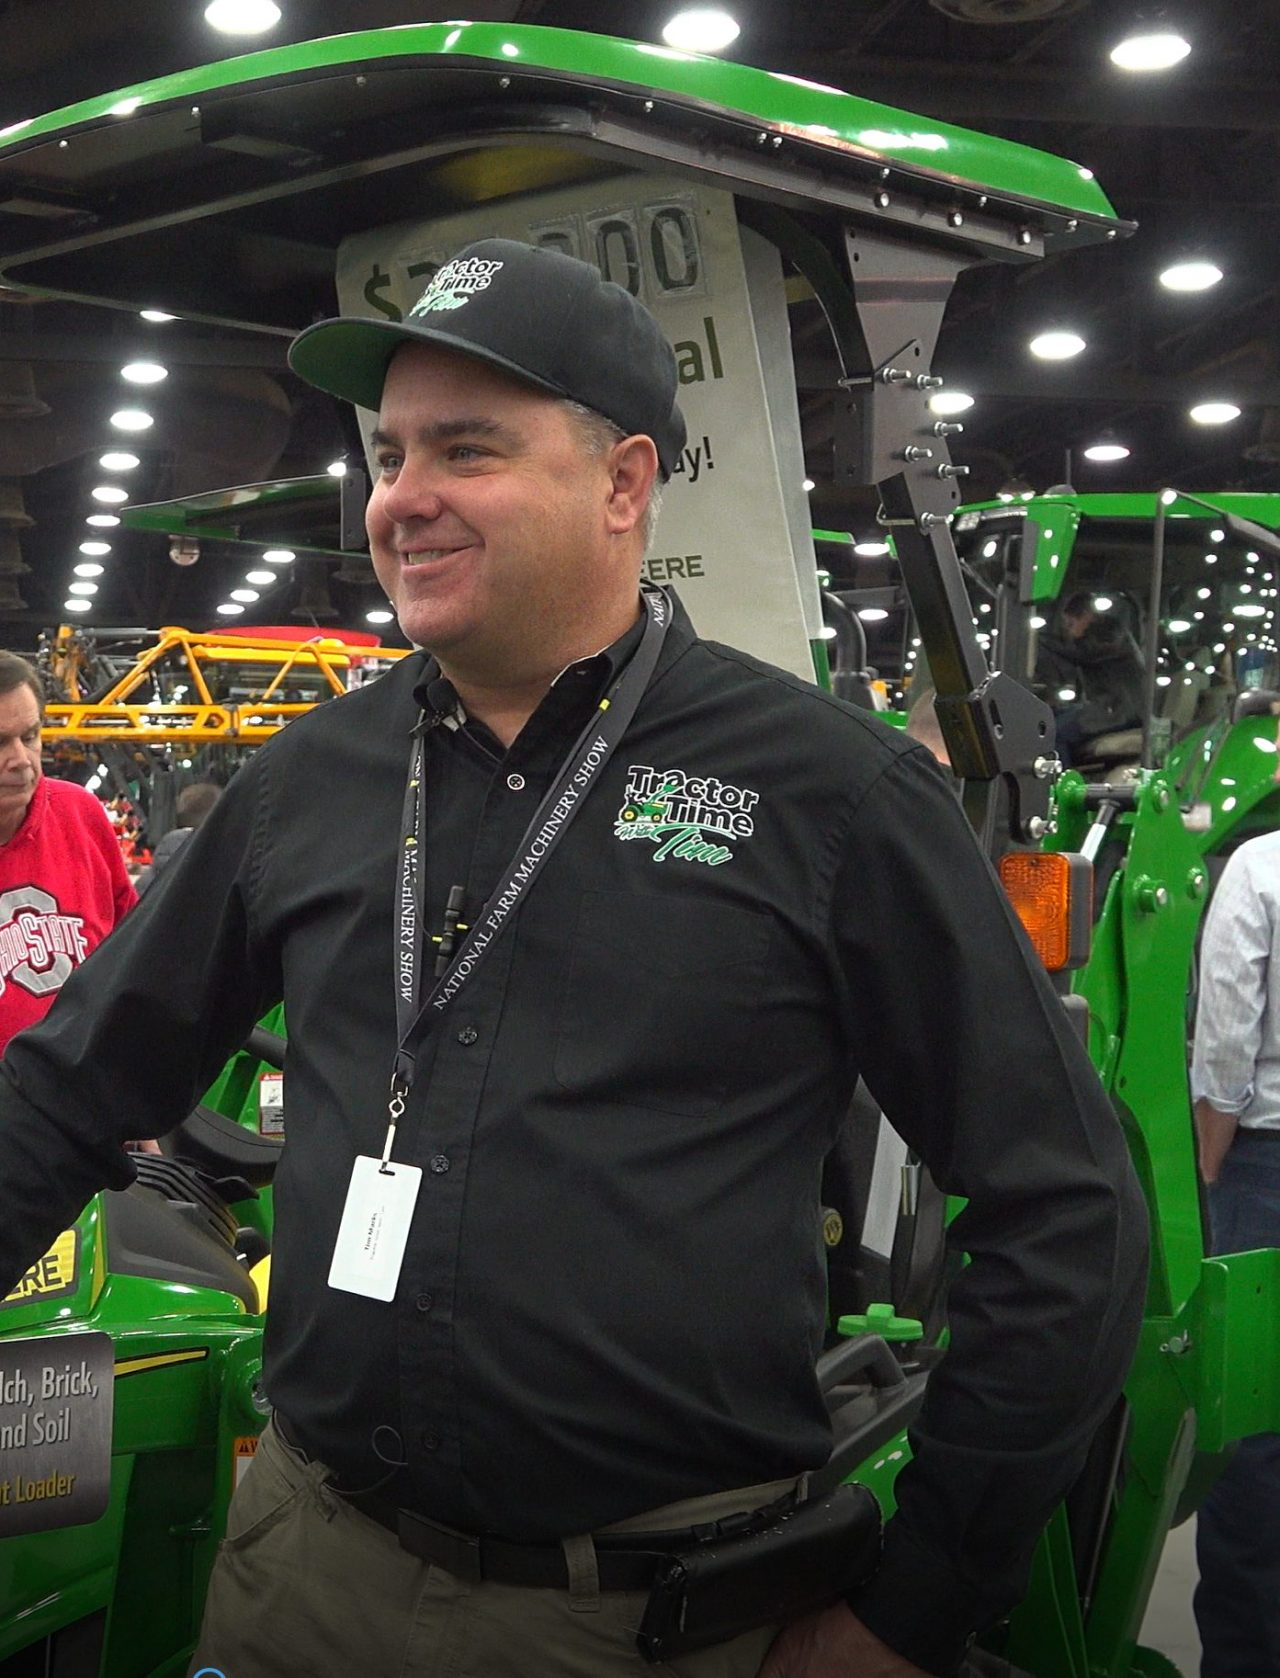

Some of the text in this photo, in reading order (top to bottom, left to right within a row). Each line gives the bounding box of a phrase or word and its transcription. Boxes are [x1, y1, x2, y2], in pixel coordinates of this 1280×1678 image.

[674, 316, 724, 385] al
[673, 436, 714, 483] ay!
[641, 555, 705, 581] ERE
[627, 765, 760, 812] Tractor
[666, 795, 754, 837] Time
[652, 823, 734, 866] Tim
[433, 735, 609, 1010] NATIONAL FARM MACHINERY SHOW
[18, 912, 88, 968] STATE
[399, 950, 414, 1003] SHOW
[13, 1254, 63, 1294] RE
[41, 1361, 98, 1399] Brick,
[32, 1408, 71, 1446] Soil
[15, 1470, 76, 1503] Loader
